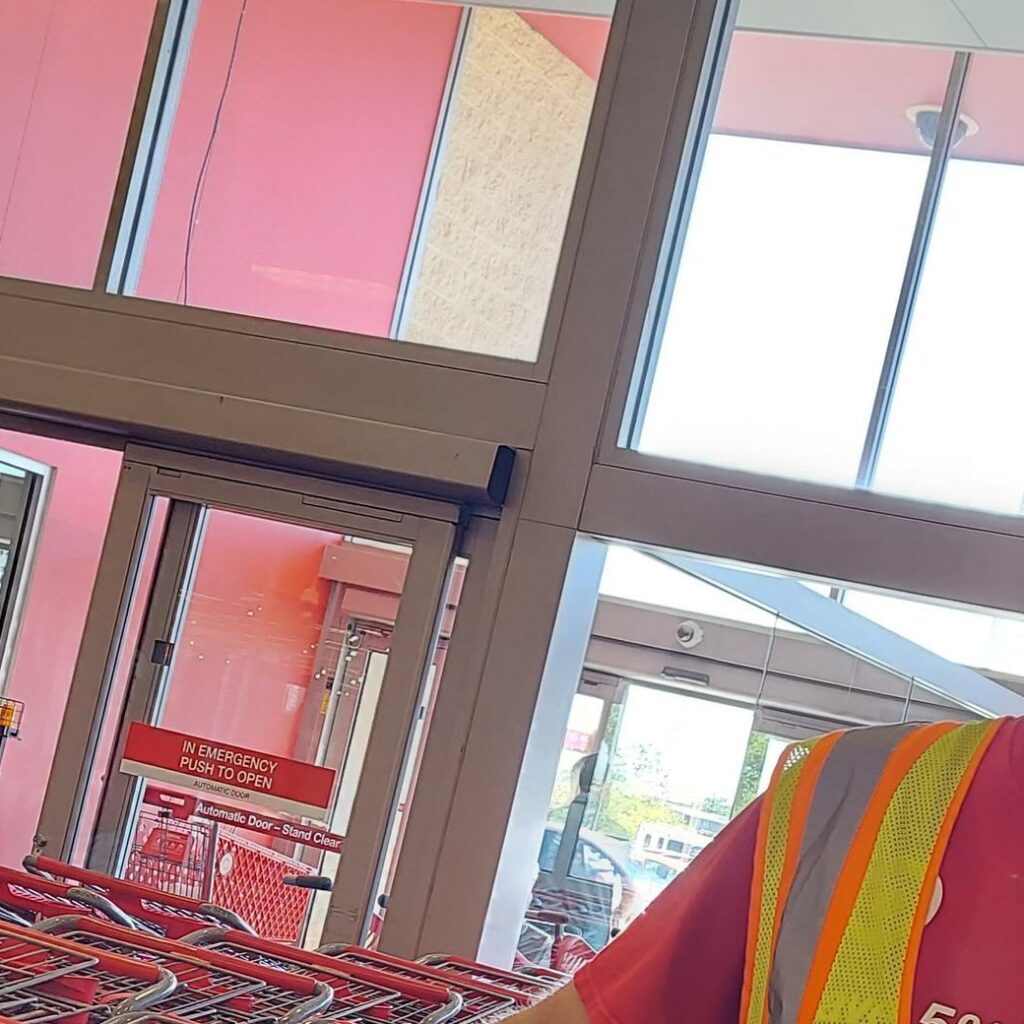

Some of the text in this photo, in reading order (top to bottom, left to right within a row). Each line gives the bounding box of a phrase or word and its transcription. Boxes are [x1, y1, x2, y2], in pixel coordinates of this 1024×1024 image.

[180, 756, 273, 790] PUSH TO OPEN
[182, 740, 279, 774] IN EMERGENCY
[193, 780, 250, 799] AUTOMATIC DOOR
[195, 802, 246, 824] Automatic
[247, 815, 275, 831] Door
[281, 823, 312, 842] Stand
[313, 832, 341, 849] Clear
